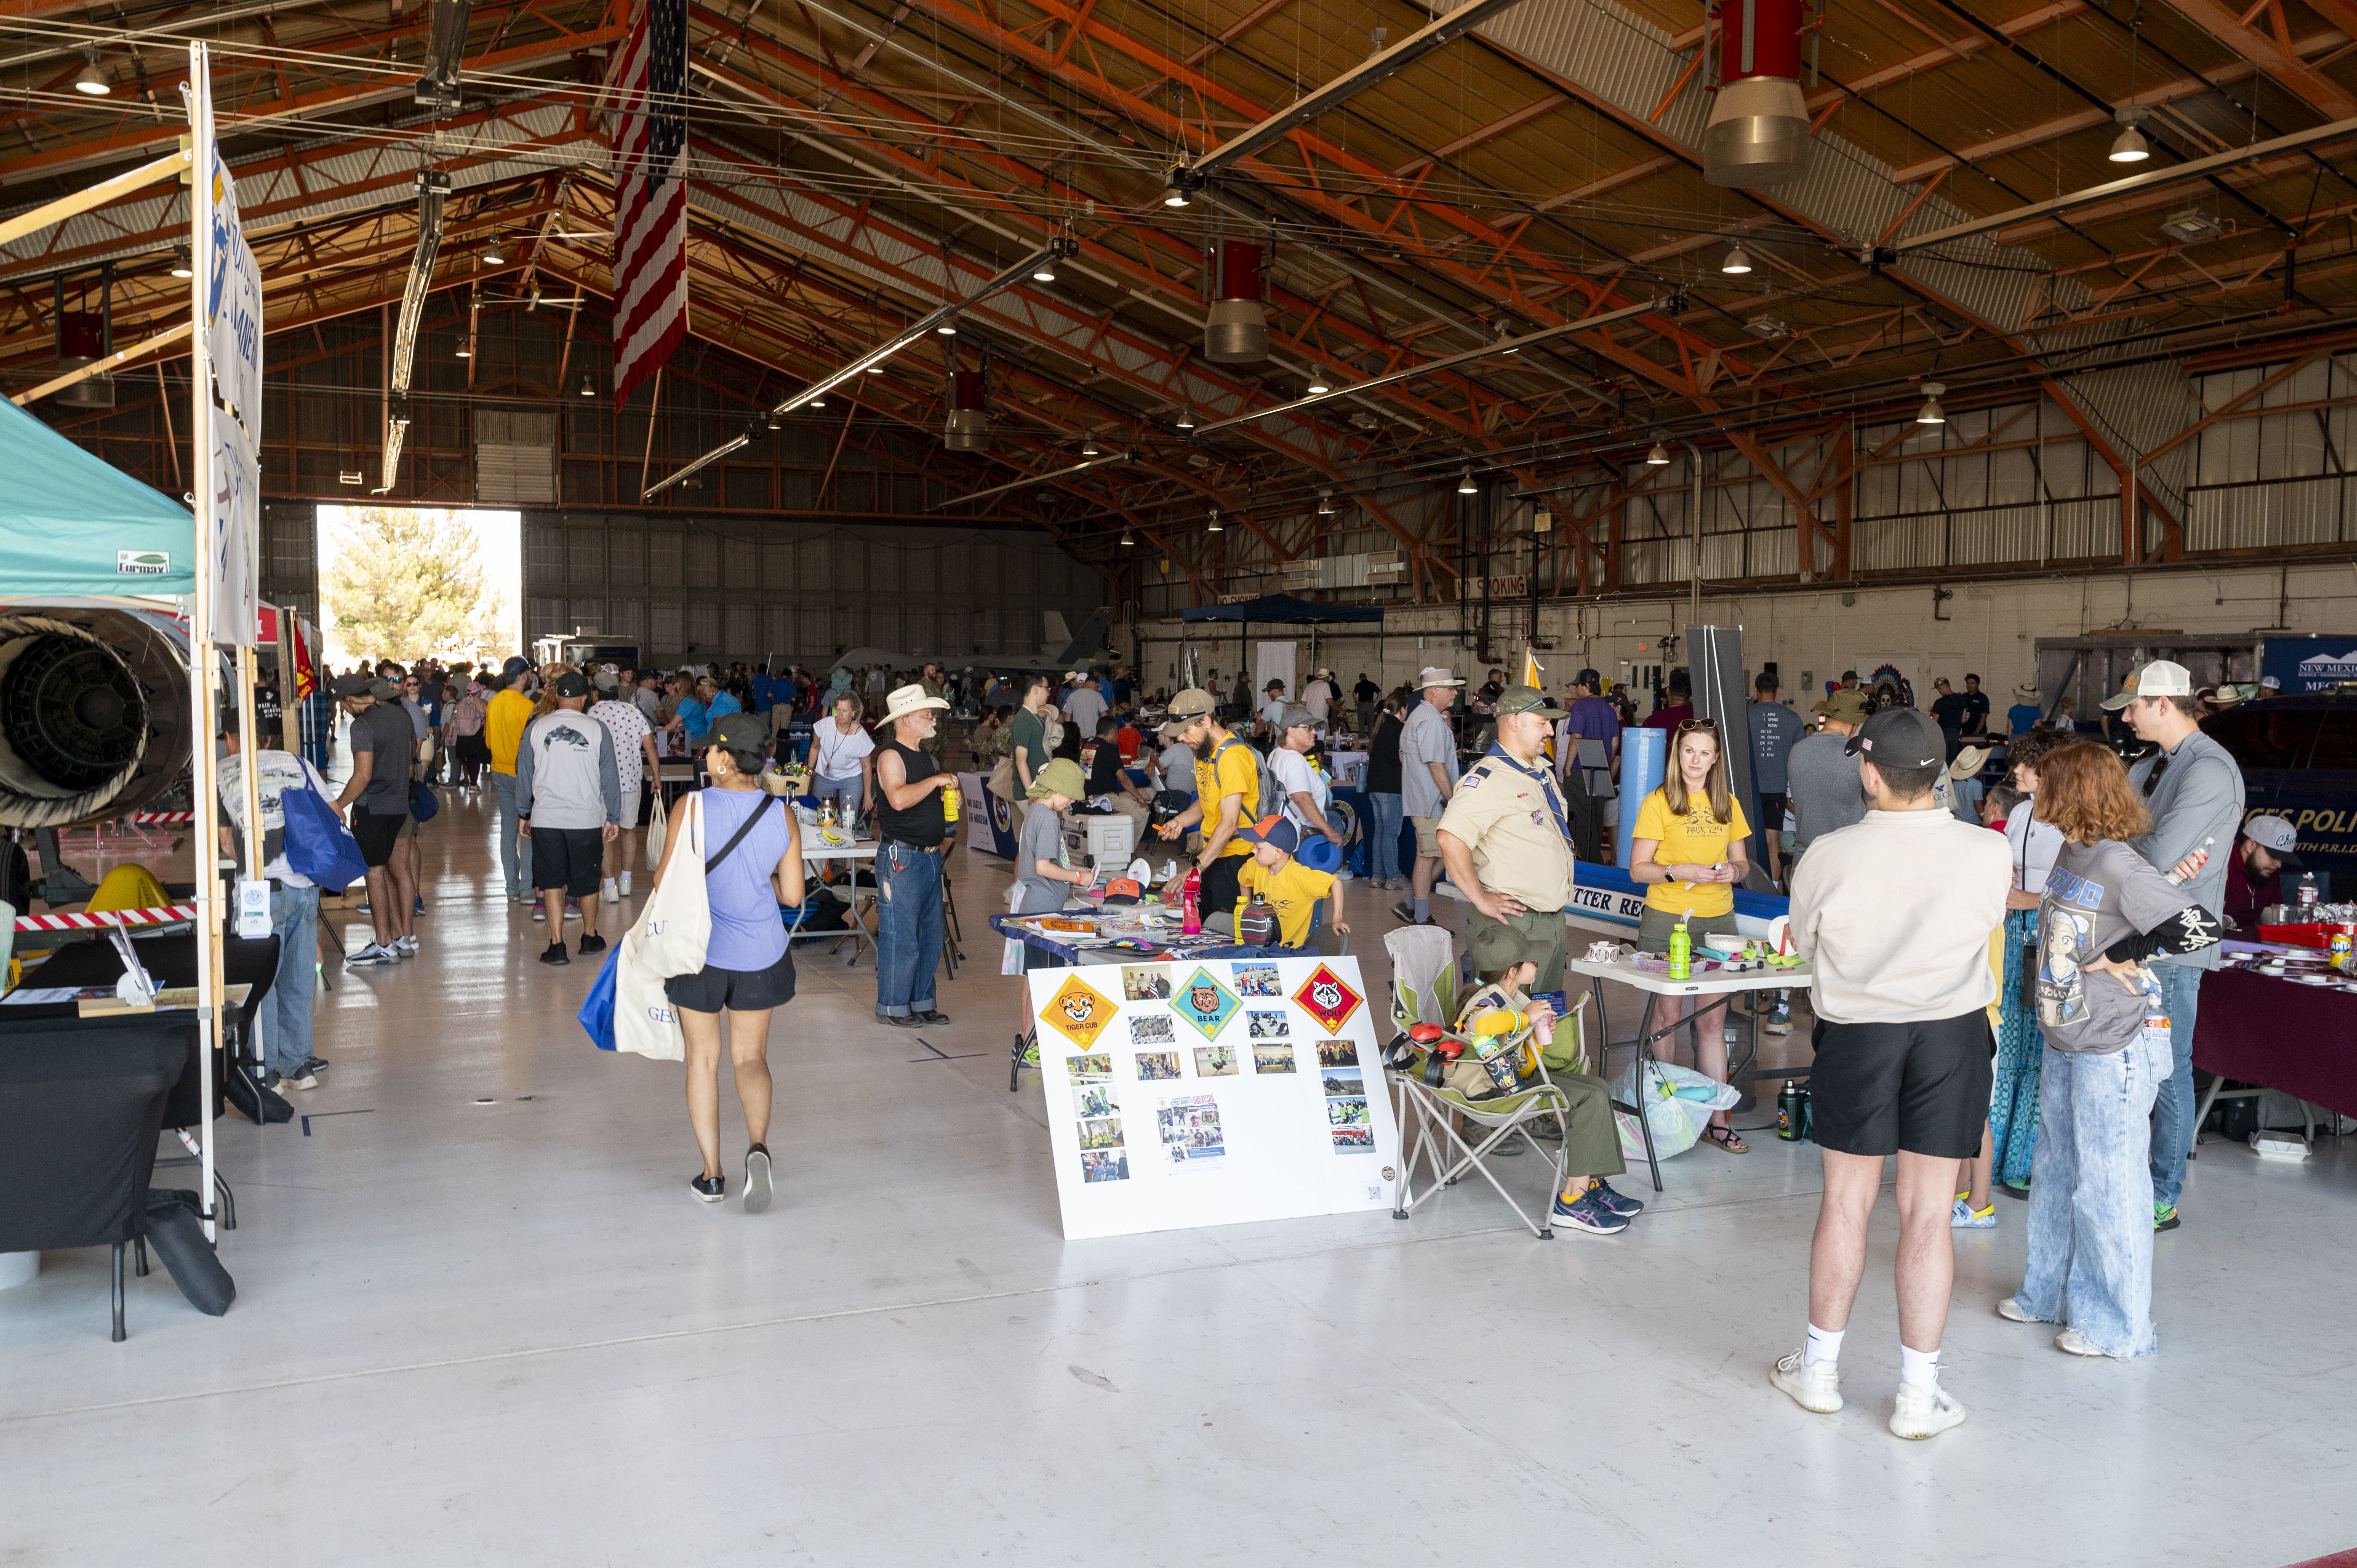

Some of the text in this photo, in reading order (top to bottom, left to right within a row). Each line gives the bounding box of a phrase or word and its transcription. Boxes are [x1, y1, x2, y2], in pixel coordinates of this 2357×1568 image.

[2299, 664, 2325, 672] NEW
[972, 799, 982, 810] EAGLES
[974, 813, 988, 826] MUSEUM
[1707, 826, 1722, 834] 124
[2045, 865, 2105, 909] TOKYO
[2330, 940, 2351, 950] ANTA
